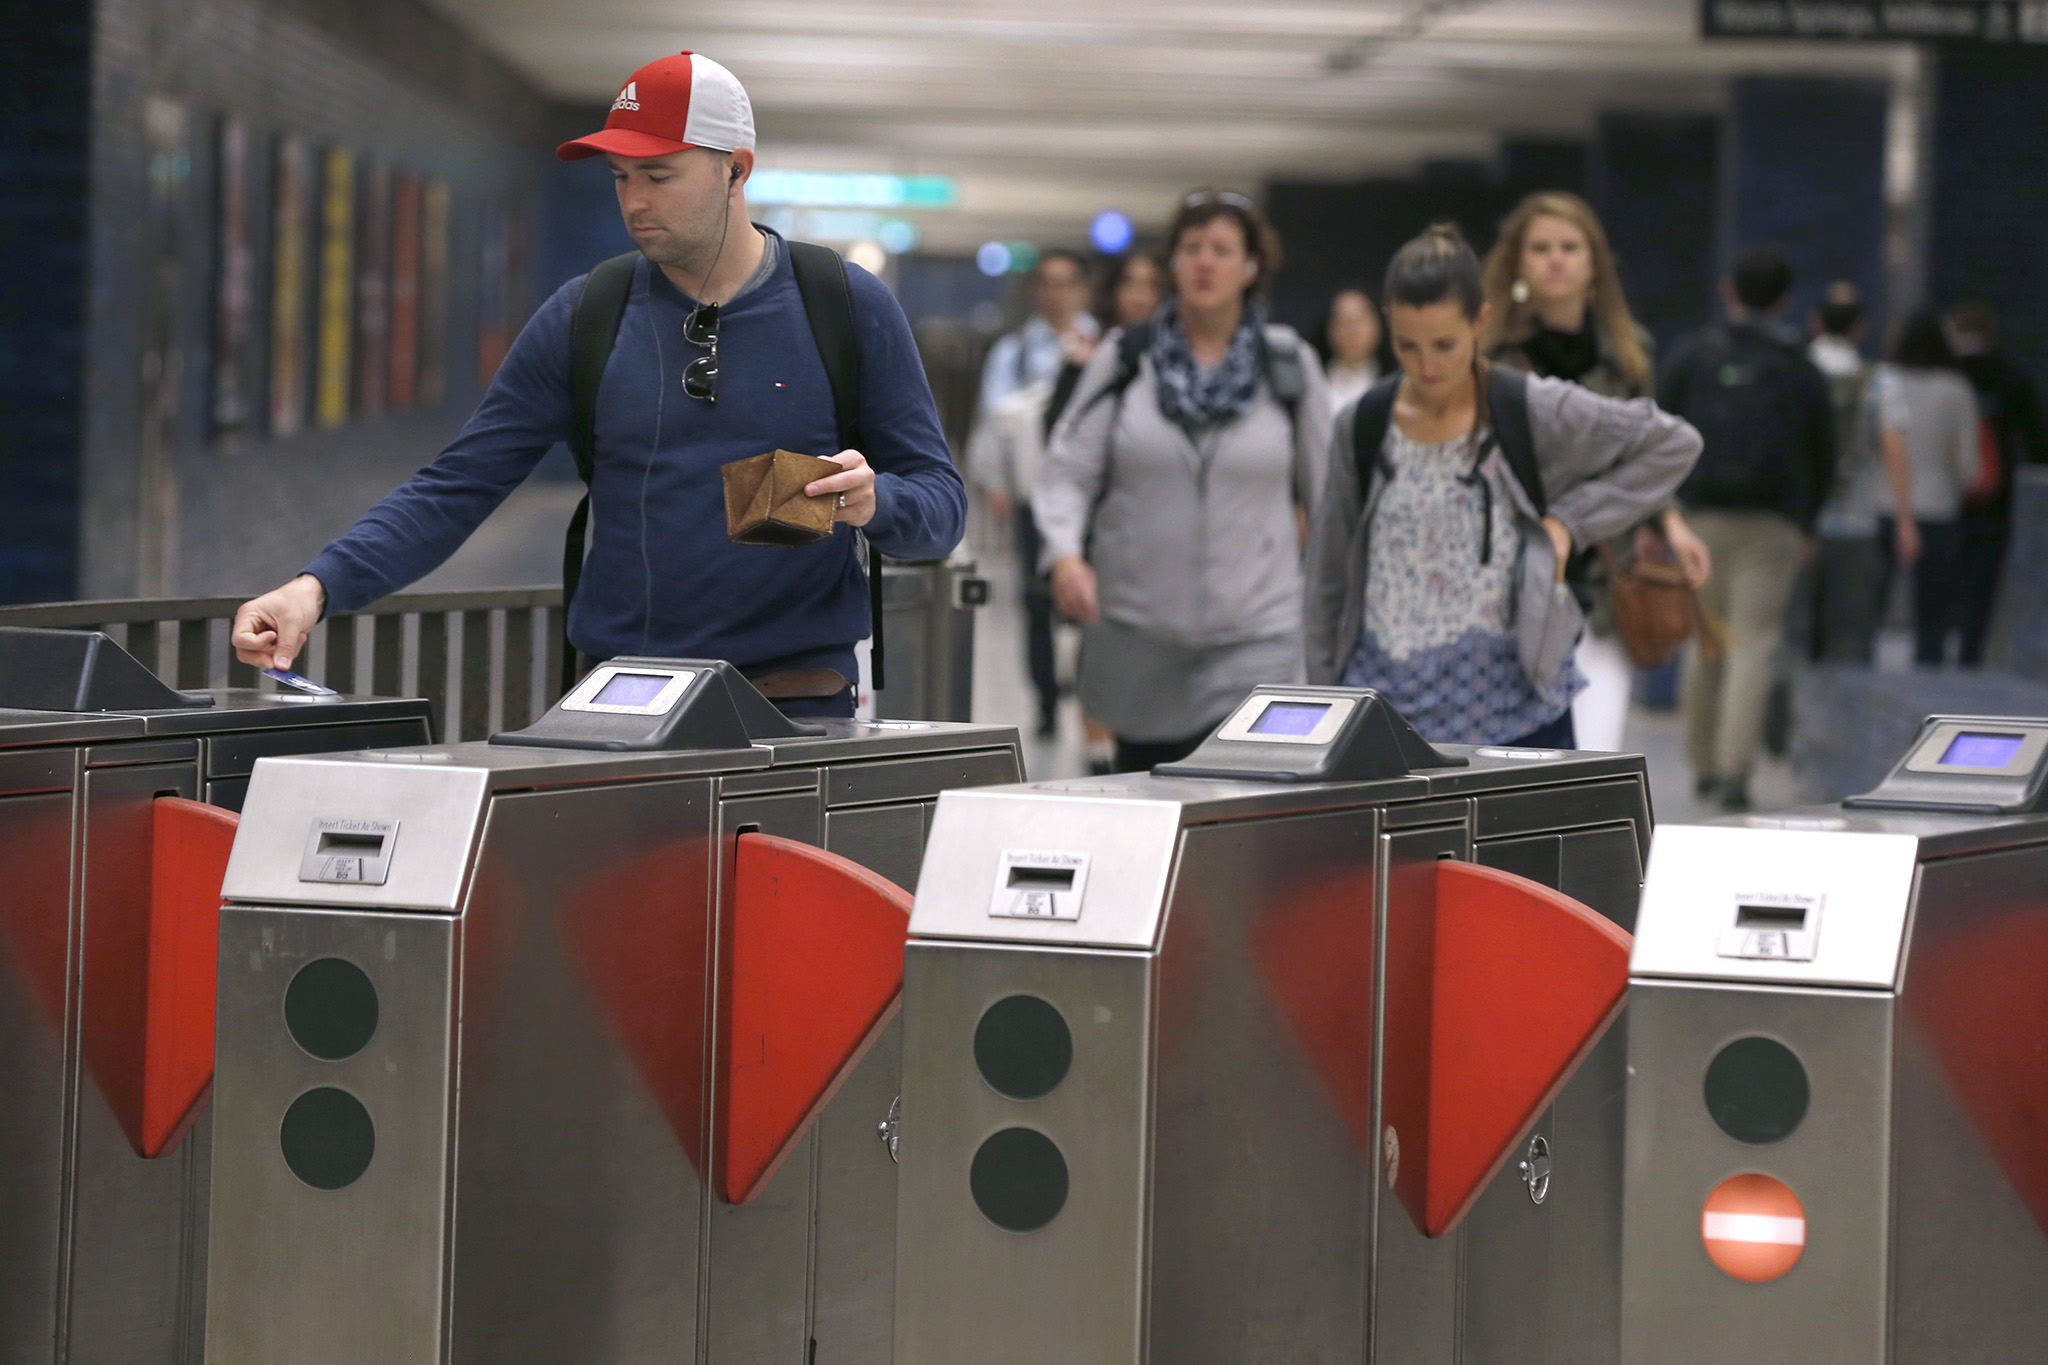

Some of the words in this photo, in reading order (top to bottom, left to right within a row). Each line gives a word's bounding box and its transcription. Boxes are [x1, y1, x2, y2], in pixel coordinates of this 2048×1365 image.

[319, 820, 338, 831] Insert
[340, 820, 360, 831] Ticket
[361, 821, 369, 832] As
[371, 822, 392, 833] Shown
